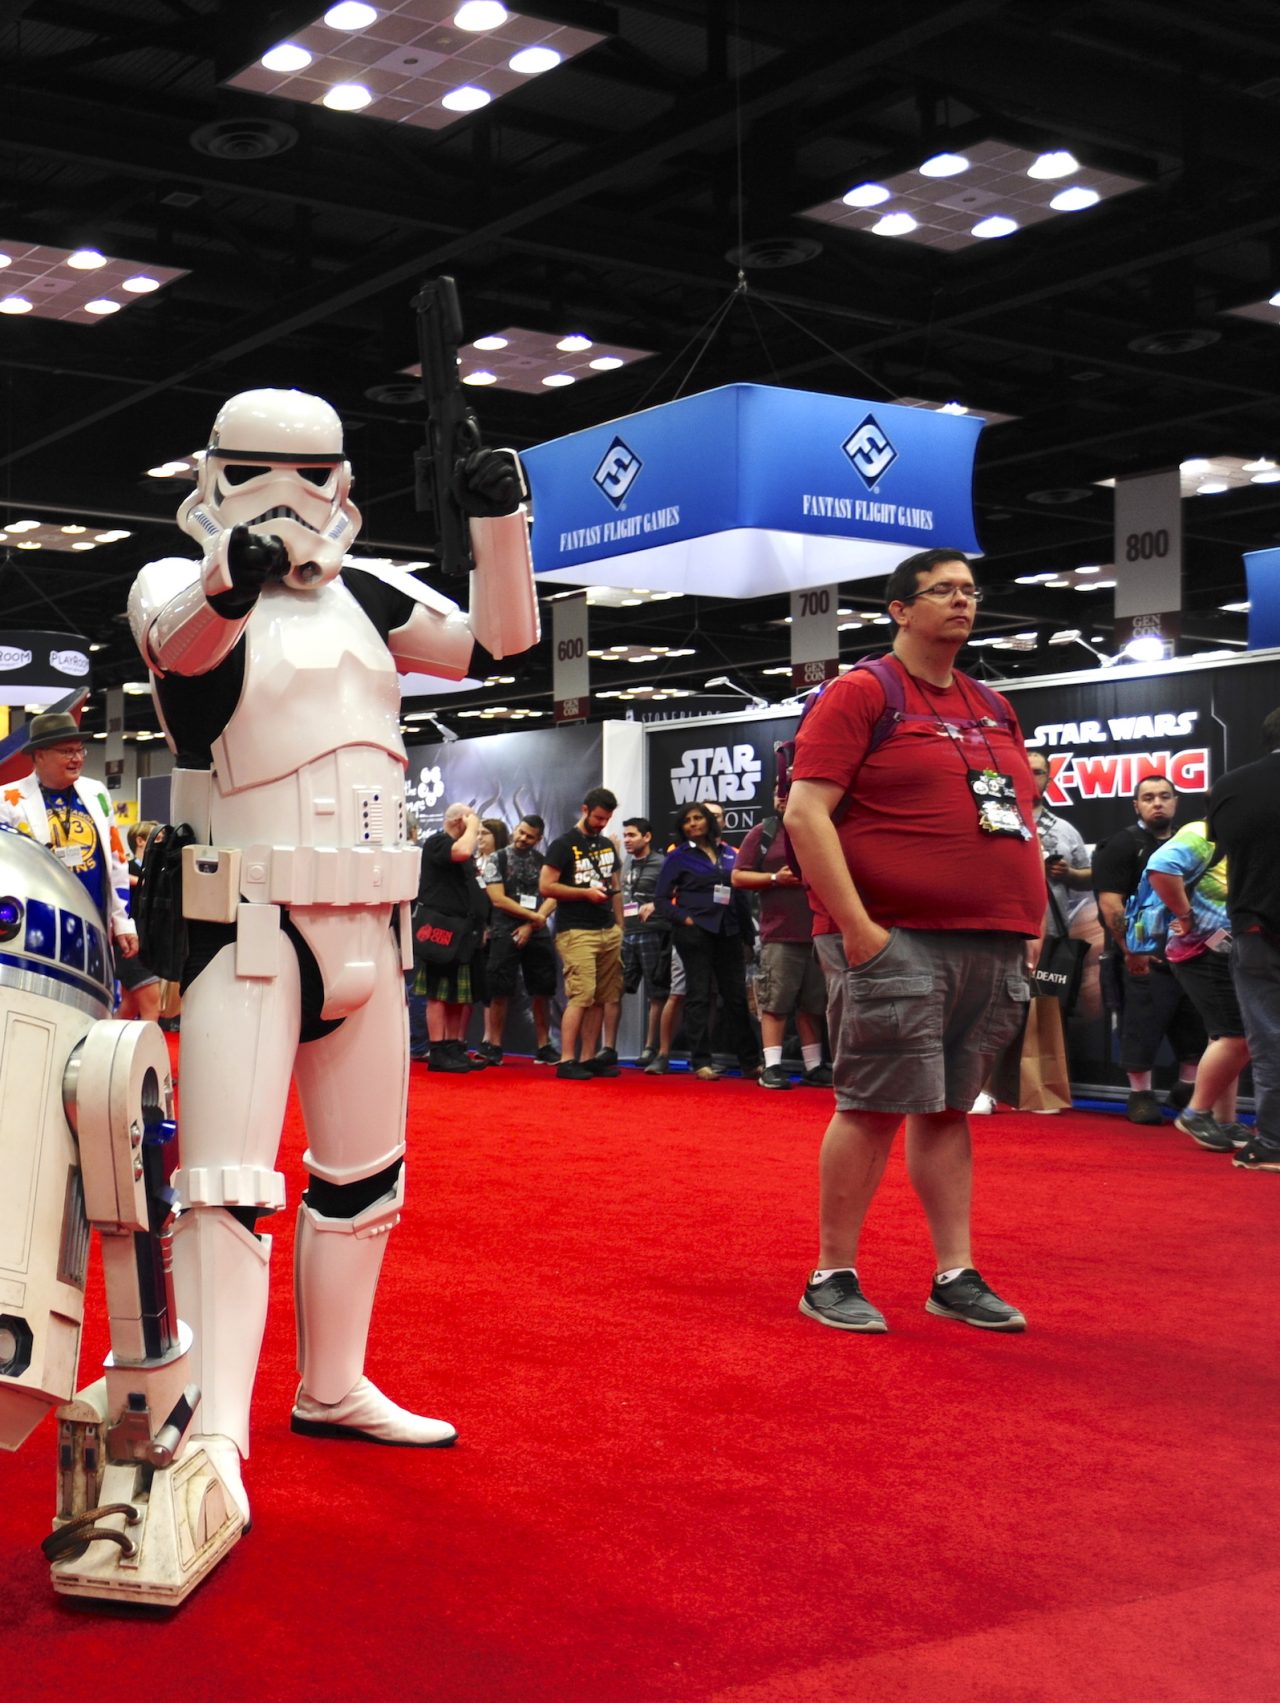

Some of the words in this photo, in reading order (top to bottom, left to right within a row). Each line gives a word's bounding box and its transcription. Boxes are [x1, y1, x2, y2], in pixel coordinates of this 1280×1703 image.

[803, 494, 853, 519] FANTASY
[855, 500, 897, 525] FLIGHT
[898, 506, 933, 531] GAMES
[560, 524, 602, 552] FANTASY
[603, 514, 642, 543] FLIGHT
[643, 505, 680, 533] GAMES
[1126, 529, 1169, 562] 800
[799, 589, 830, 617] 700
[1132, 614, 1162, 628] GEN
[558, 638, 584, 661] 600
[804, 661, 826, 673] GEN
[804, 671, 826, 682] CON
[1024, 720, 1107, 747] STAR
[1107, 711, 1198, 740] WARS
[670, 744, 762, 778] STAR
[670, 771, 762, 805] WARS
[1036, 970, 1067, 985] DEATH
